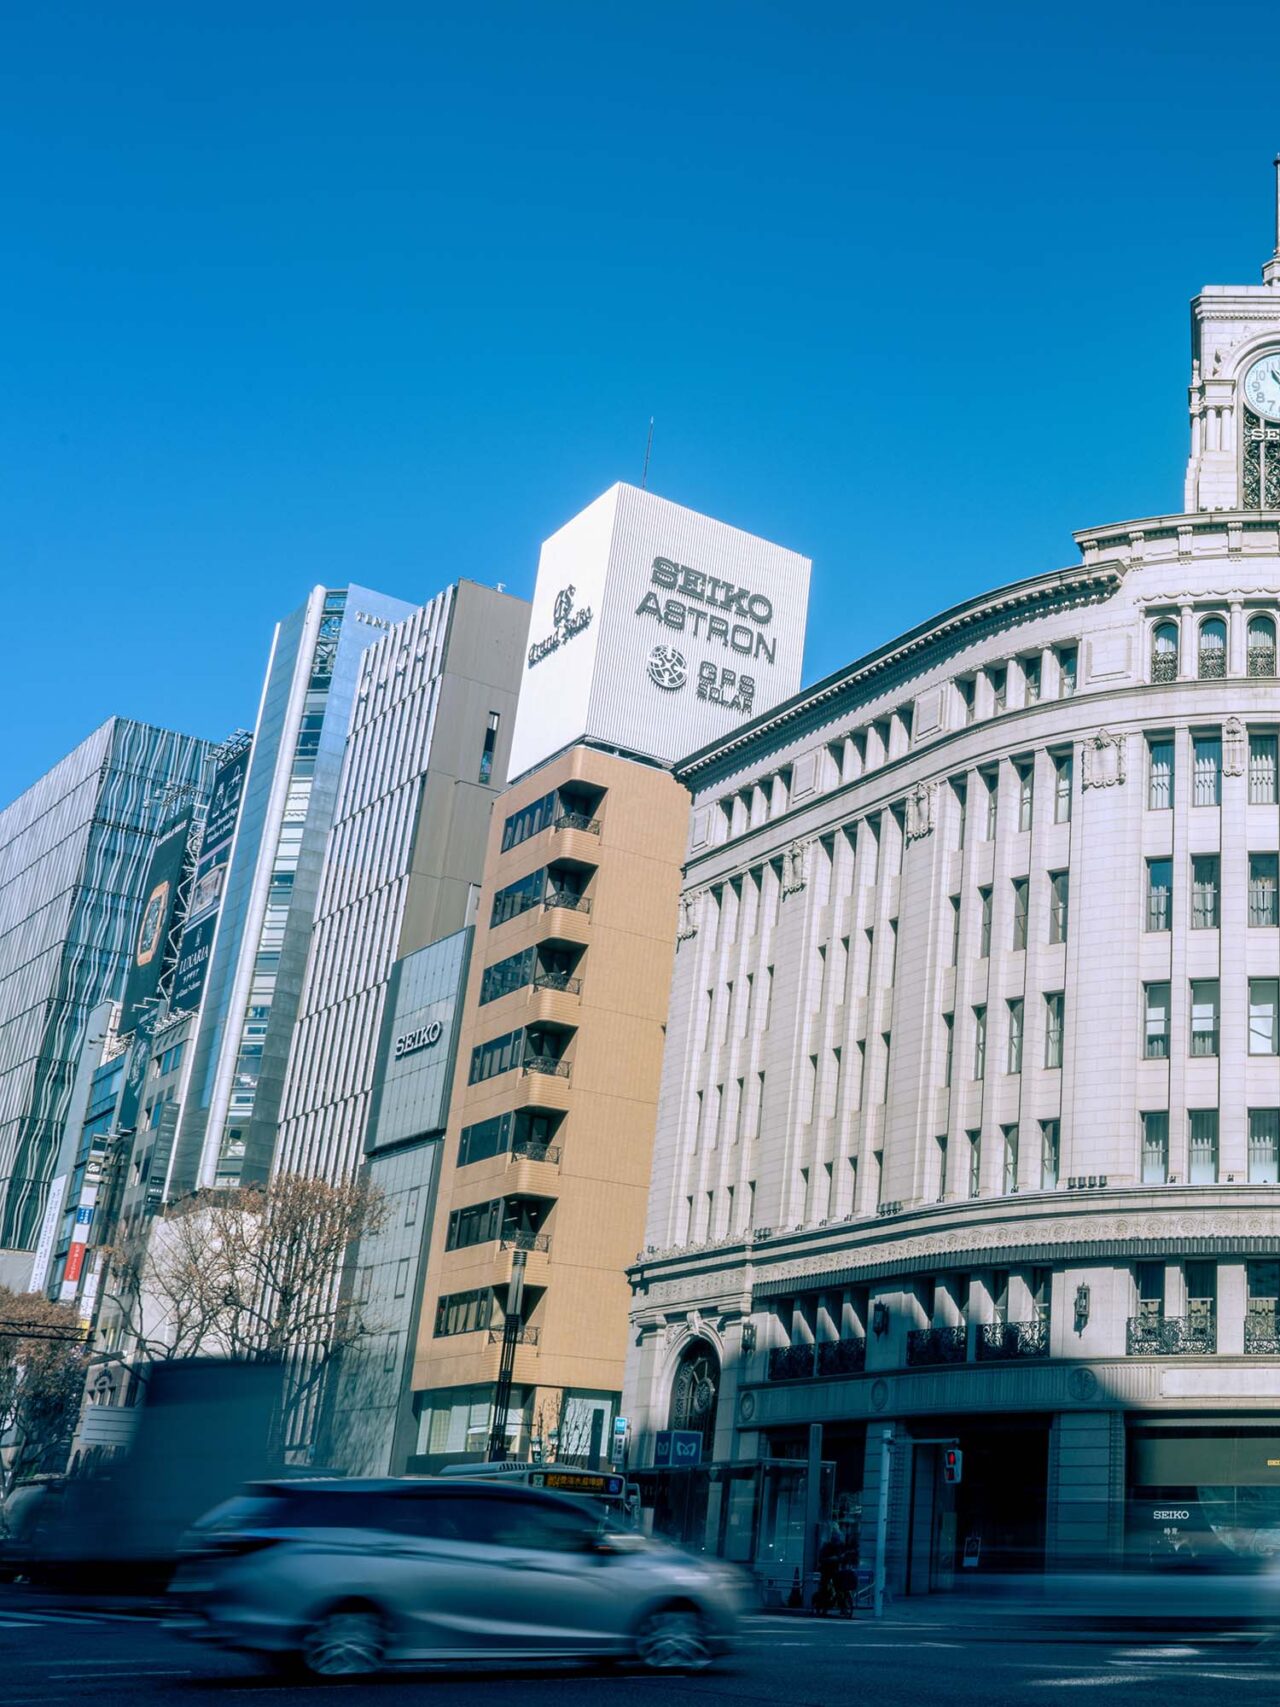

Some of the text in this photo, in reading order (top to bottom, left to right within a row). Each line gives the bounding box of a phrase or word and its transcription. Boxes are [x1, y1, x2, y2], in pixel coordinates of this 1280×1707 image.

[1251, 381, 1260, 392] 9
[1255, 370, 1266, 381] 10
[1256, 392, 1265, 403] 8
[1267, 400, 1276, 411] 7
[651, 556, 773, 626] SEIKO
[635, 591, 777, 664] ASTRON
[528, 627, 561, 669] Grand
[699, 660, 755, 699] GPS
[697, 684, 753, 714] SOLAR
[394, 1021, 442, 1057] SEIKO
[1153, 1510, 1190, 1520] SEIKO
